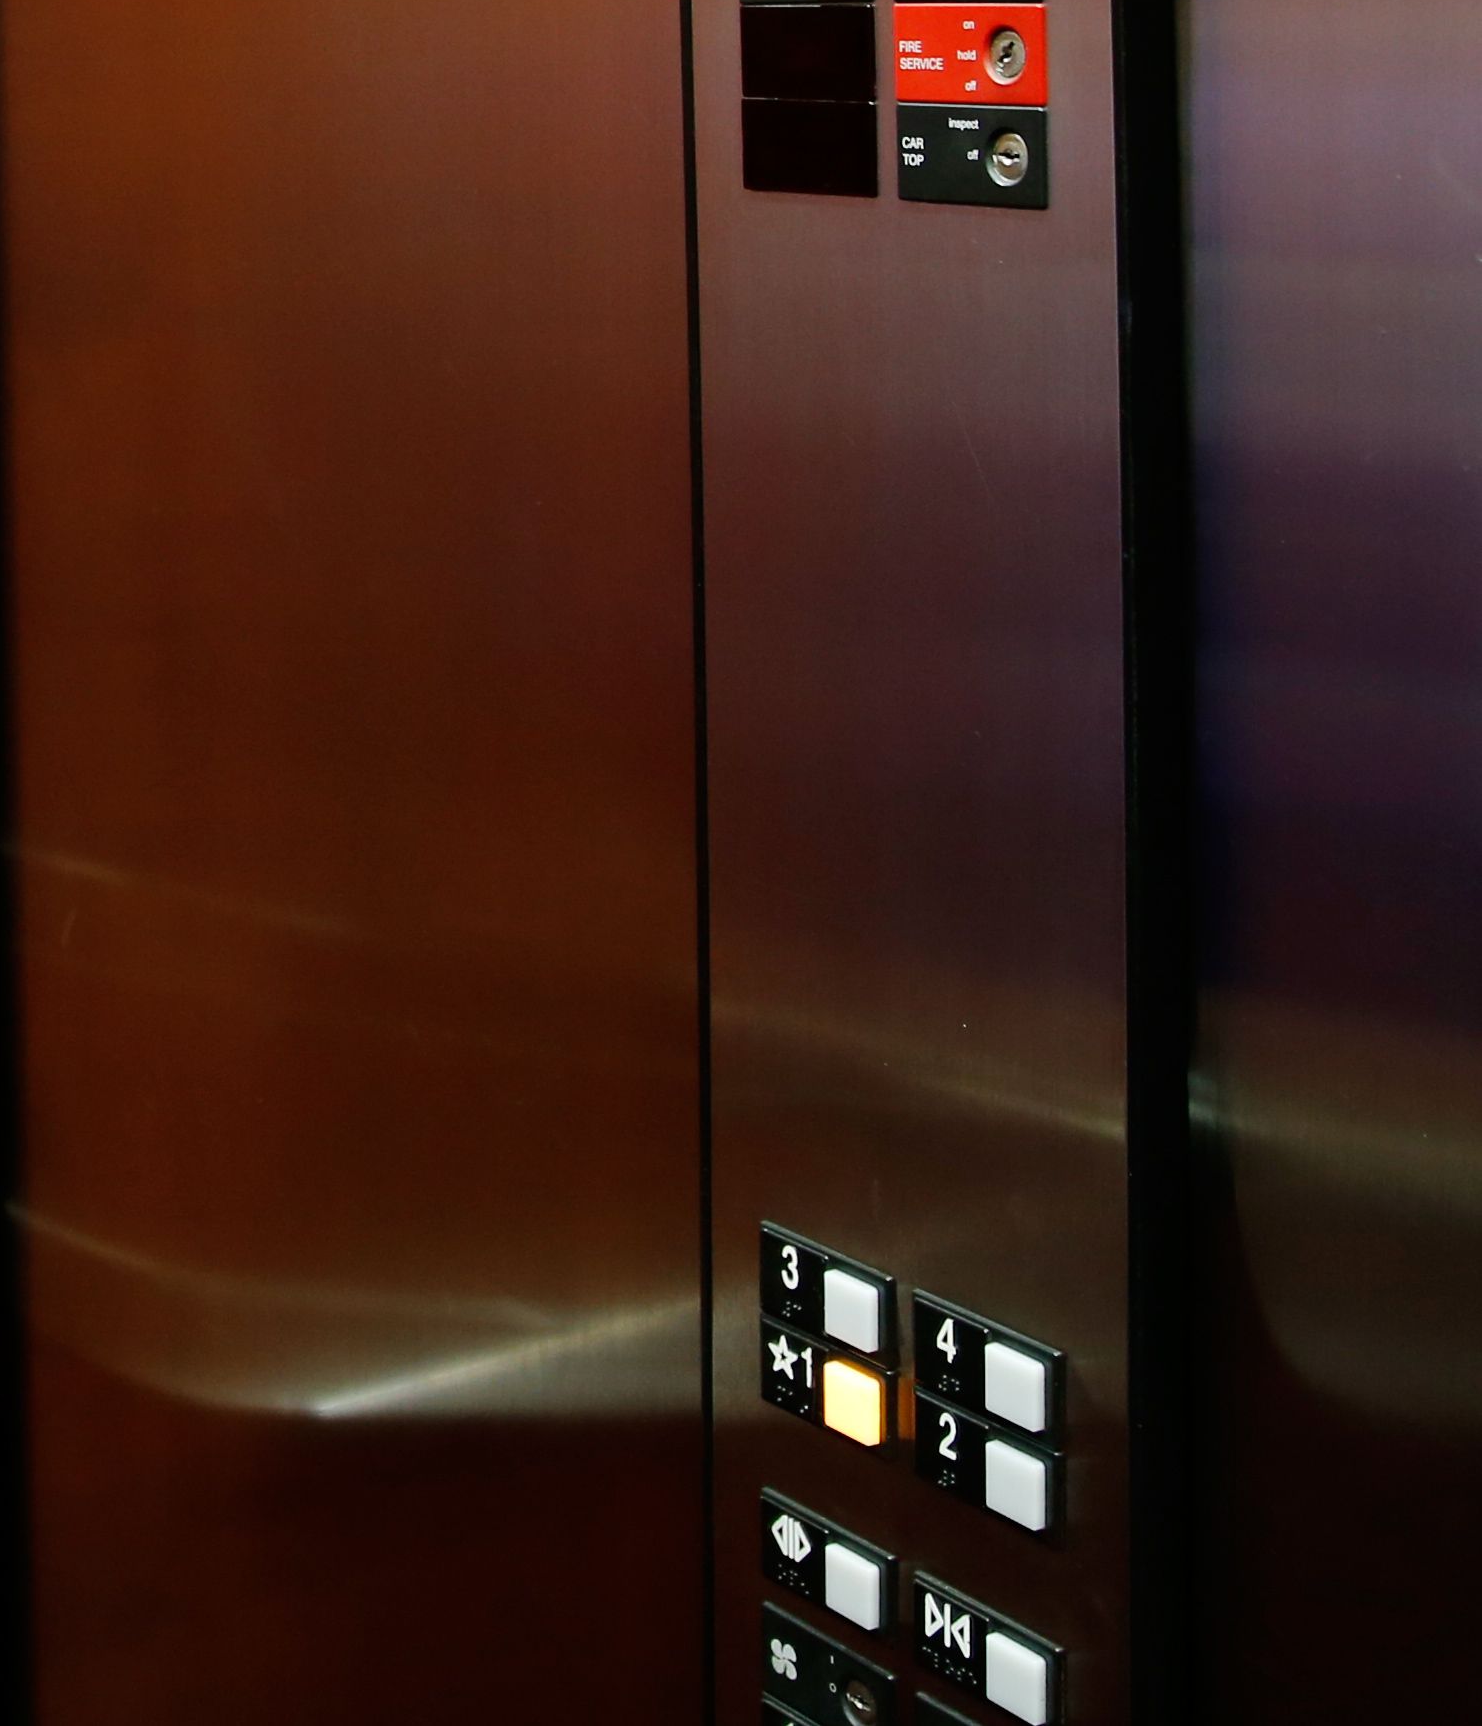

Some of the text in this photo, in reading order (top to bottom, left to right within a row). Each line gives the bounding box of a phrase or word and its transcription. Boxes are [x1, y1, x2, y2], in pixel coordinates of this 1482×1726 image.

[962, 20, 976, 30] on
[899, 40, 923, 53] FIRE
[956, 49, 977, 61] hold
[899, 57, 945, 71] SERVICE
[964, 79, 978, 92] off
[948, 117, 980, 131] inspect
[901, 136, 925, 150] CAR
[901, 153, 925, 166] TOP
[966, 148, 979, 161] off
[781, 1244, 799, 1290] 3
[936, 1317, 957, 1364] 4
[938, 1412, 958, 1461] 2
